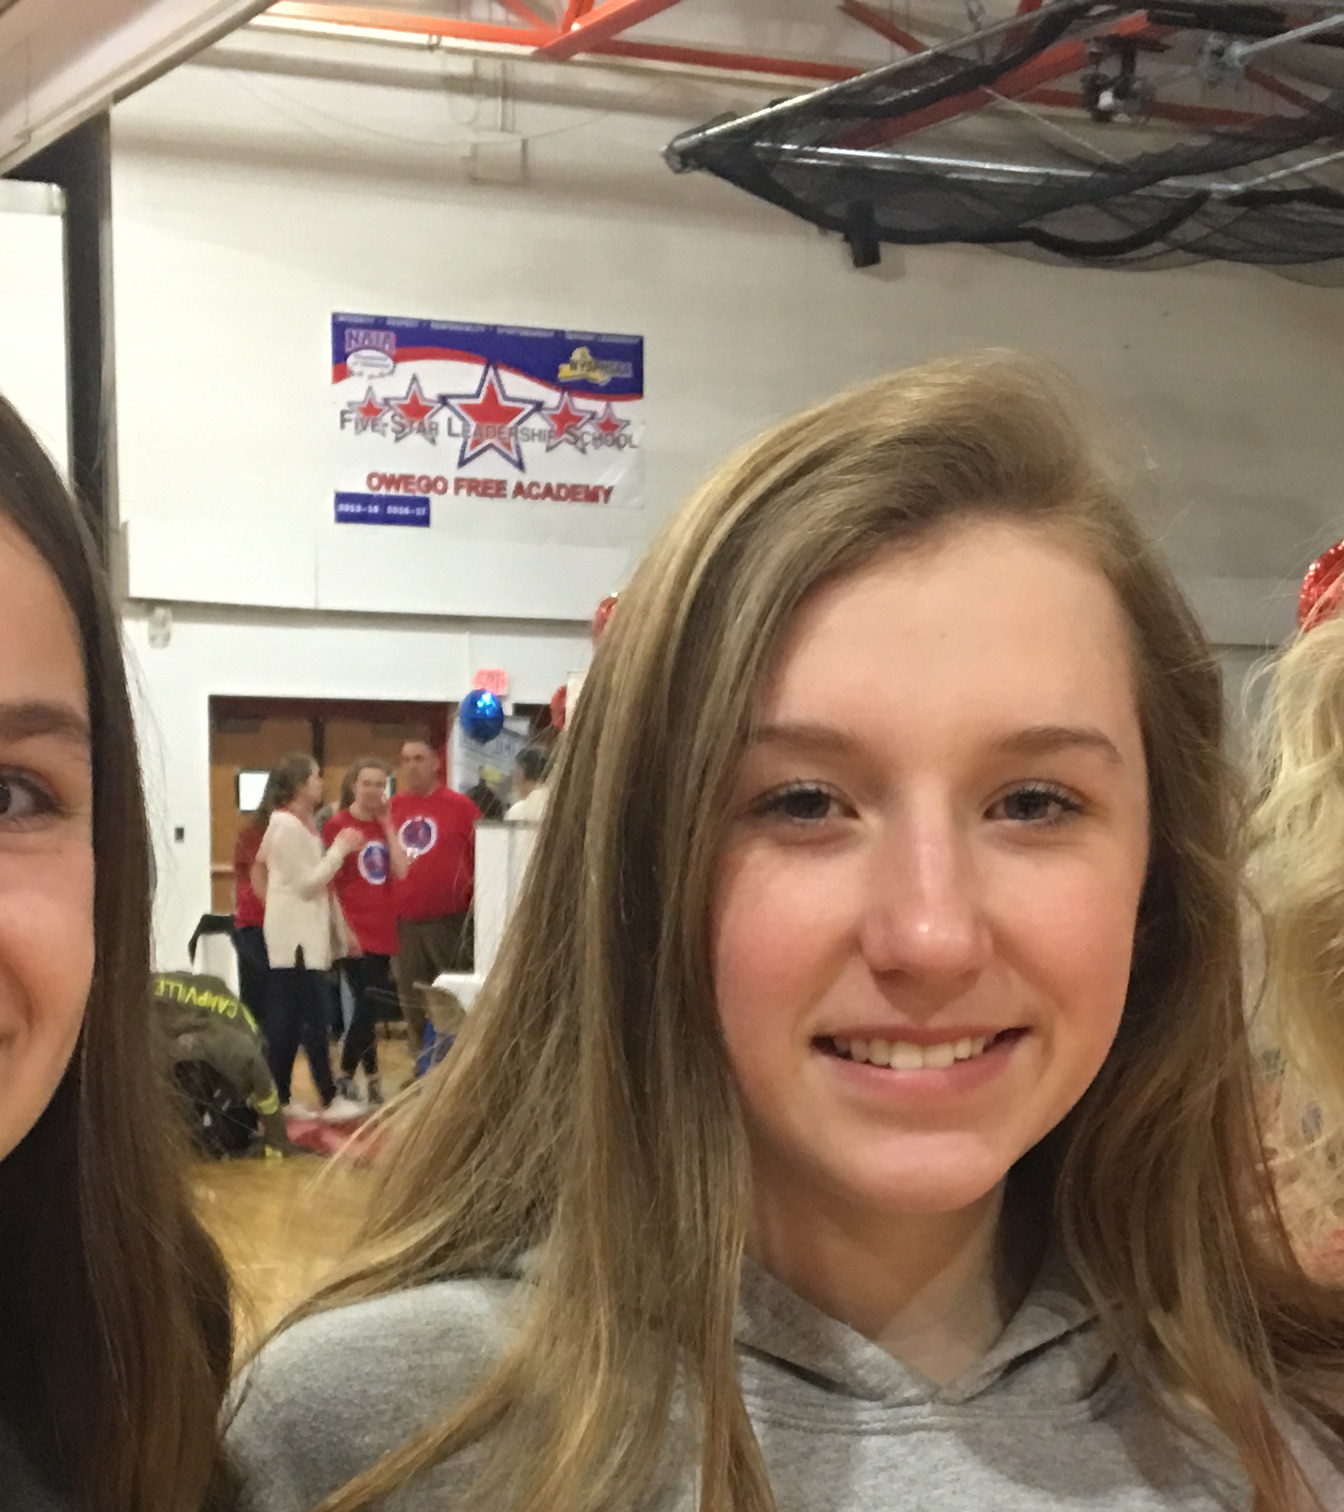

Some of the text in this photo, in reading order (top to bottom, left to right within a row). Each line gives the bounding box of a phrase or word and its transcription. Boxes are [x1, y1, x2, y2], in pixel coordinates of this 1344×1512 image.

[563, 424, 640, 450] SCHOOL
[366, 472, 615, 505] OWEGO FREE ACADEMY
